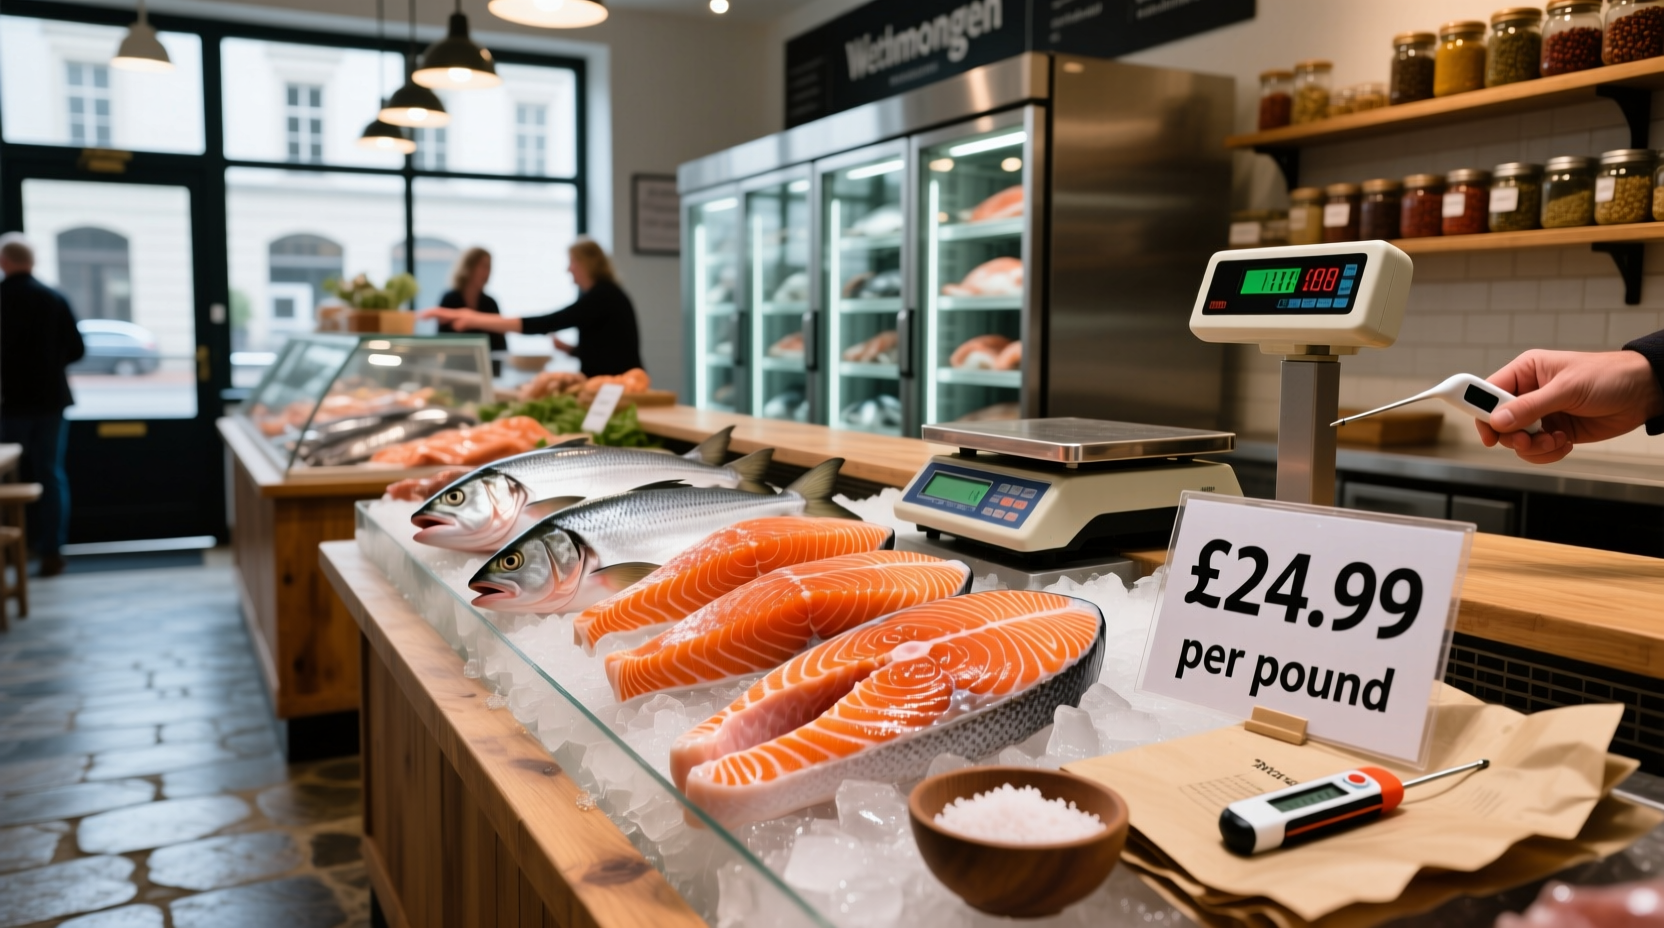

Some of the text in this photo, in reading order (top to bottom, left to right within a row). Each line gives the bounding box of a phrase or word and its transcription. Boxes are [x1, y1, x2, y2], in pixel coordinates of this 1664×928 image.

[1184, 539, 1423, 639] £24.99
[1175, 638, 1395, 713] per pound
